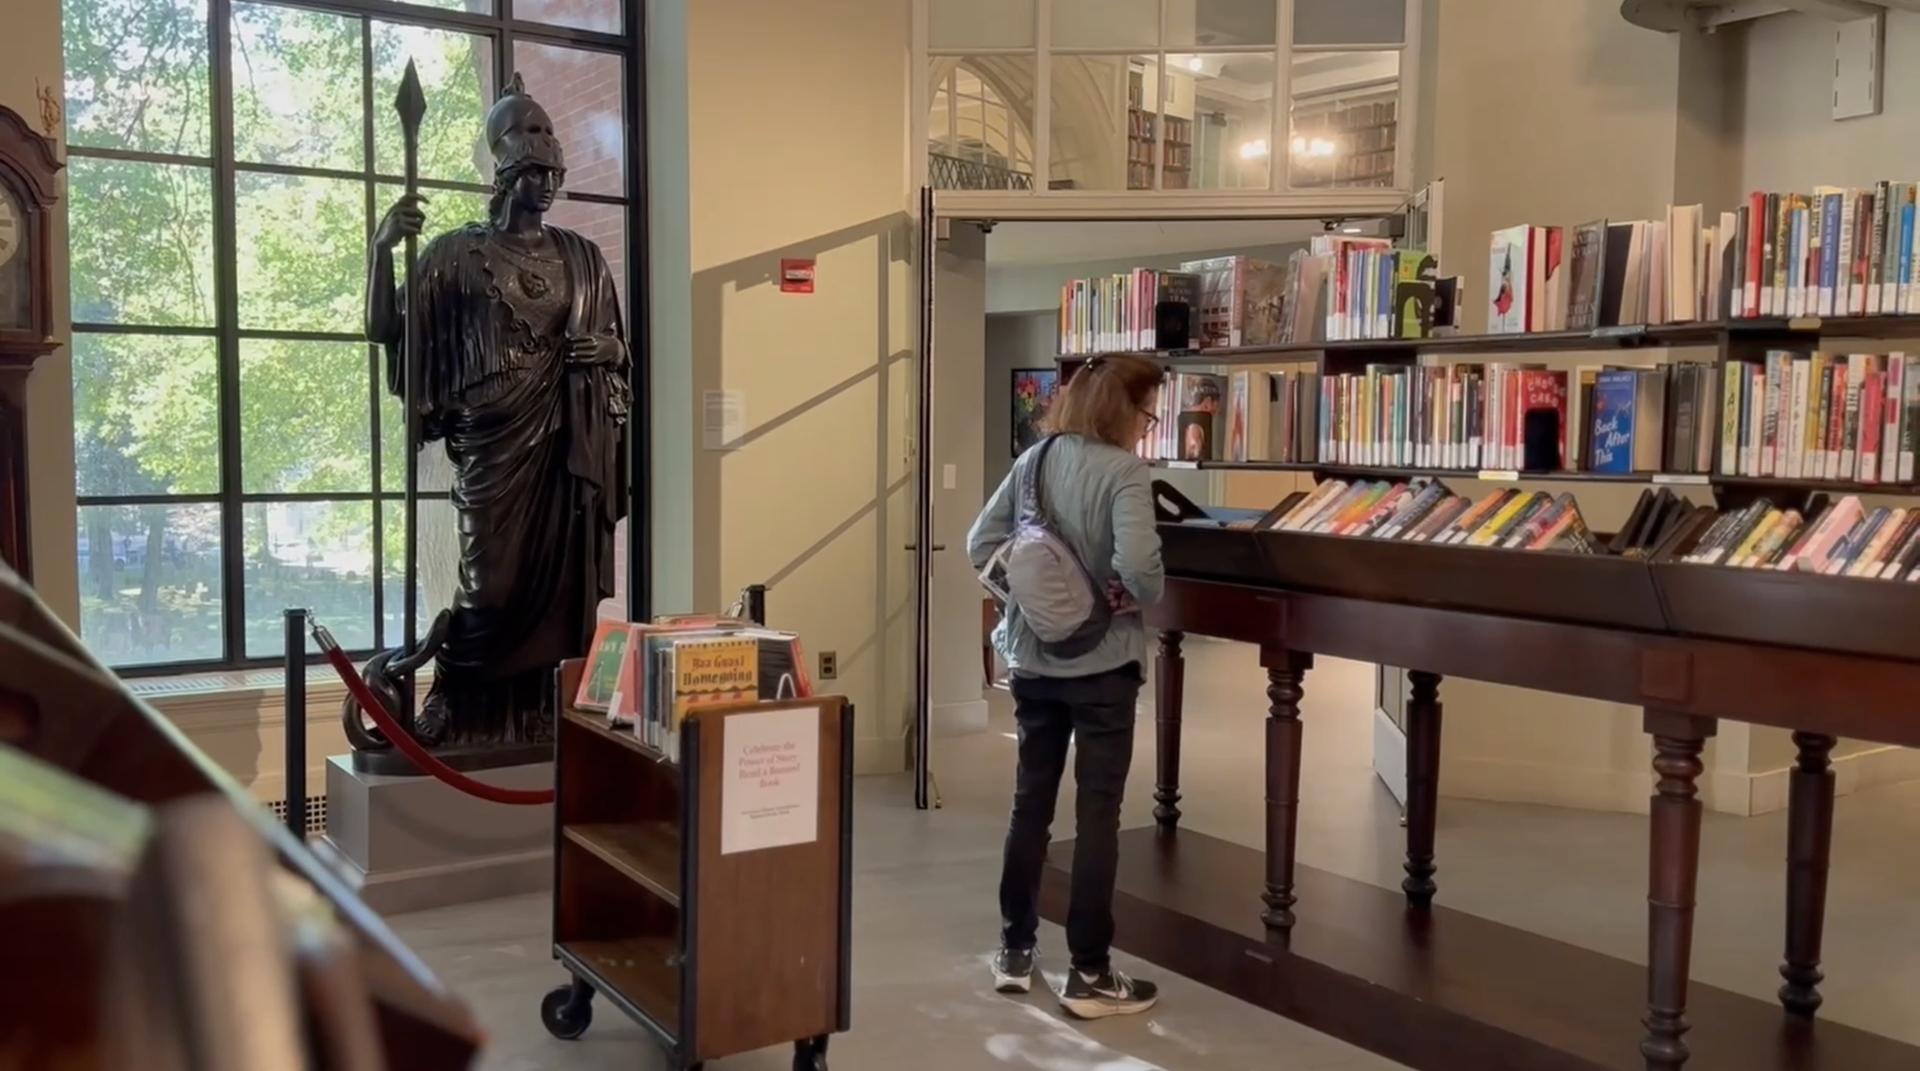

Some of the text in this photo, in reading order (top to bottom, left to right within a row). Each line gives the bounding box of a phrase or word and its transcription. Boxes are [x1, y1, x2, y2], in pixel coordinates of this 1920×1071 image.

[1594, 416, 1618, 436] Back
[1605, 431, 1630, 449] After
[1594, 448, 1614, 466] This
[783, 741, 796, 750] the
[739, 757, 764, 767] Power
[739, 768, 761, 779] Read
